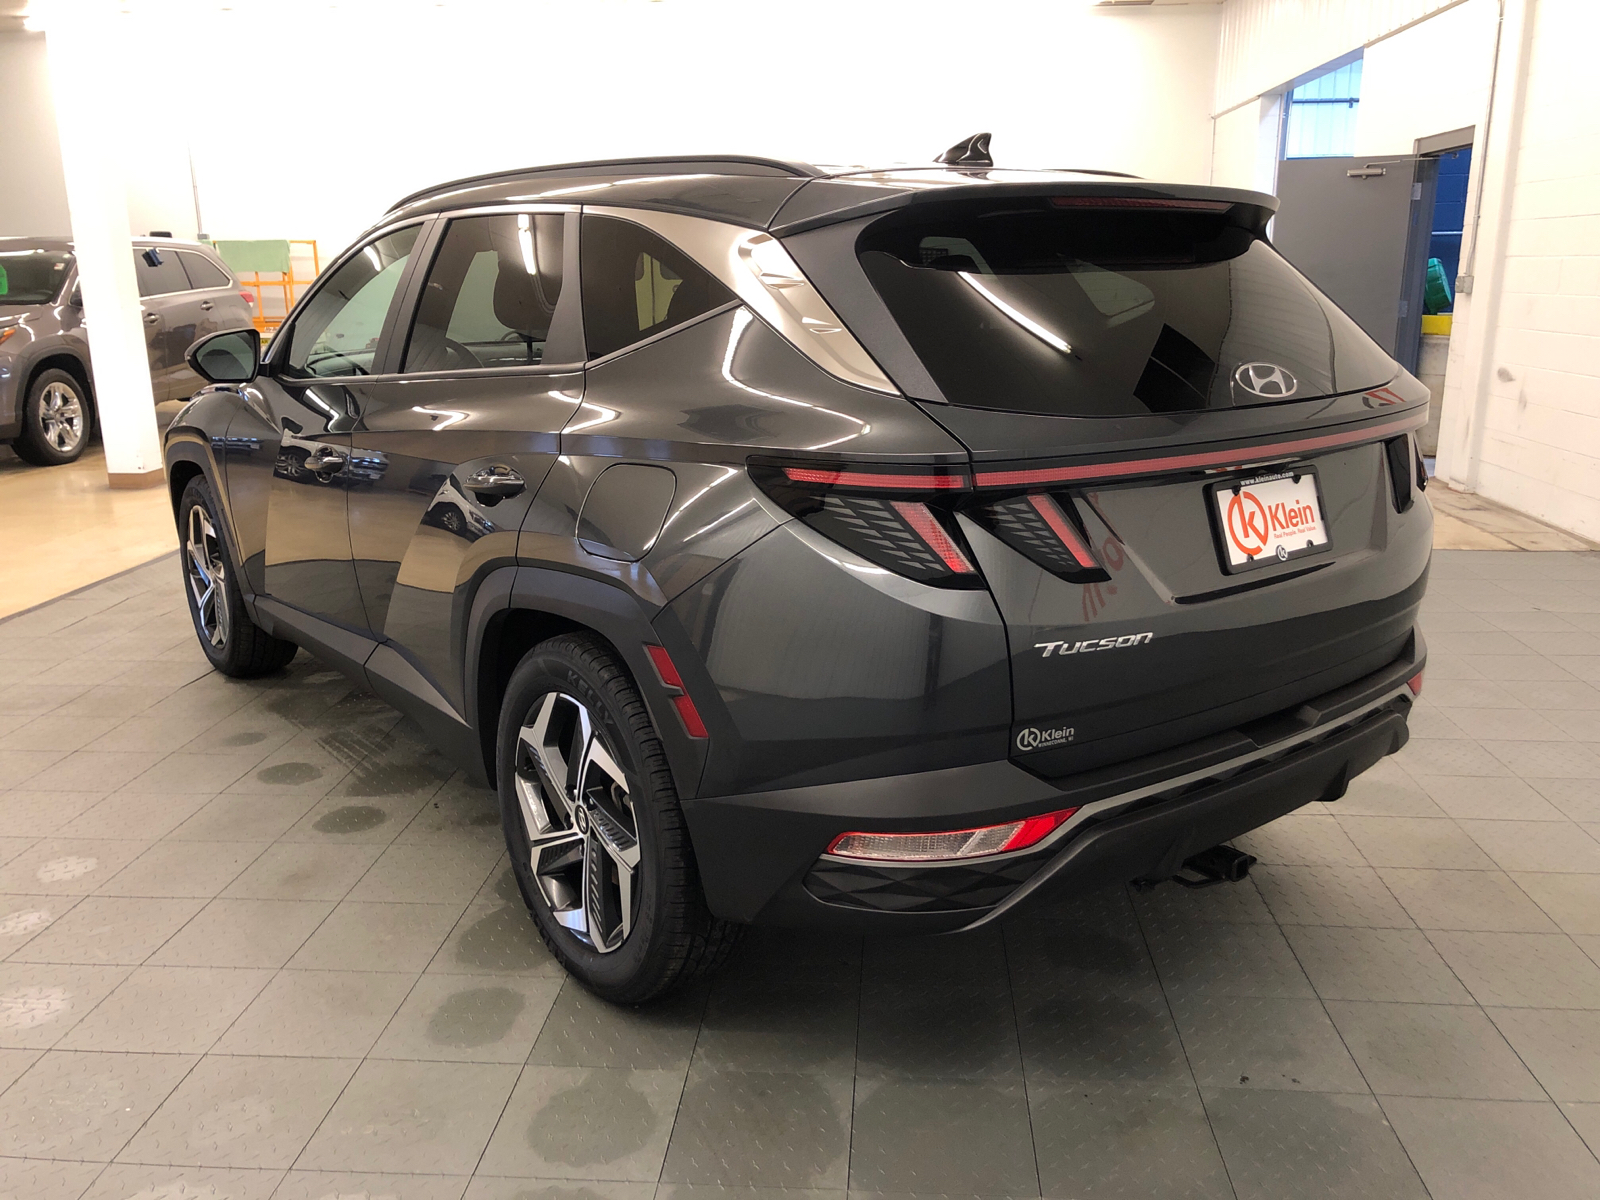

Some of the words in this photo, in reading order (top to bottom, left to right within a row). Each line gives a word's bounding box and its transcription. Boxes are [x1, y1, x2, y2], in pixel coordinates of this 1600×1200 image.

[1240, 471, 1295, 486] www.kleinauto.com
[1268, 499, 1315, 532] Klein
[567, 669, 615, 725] KELLY
[1041, 726, 1075, 742] Klein
